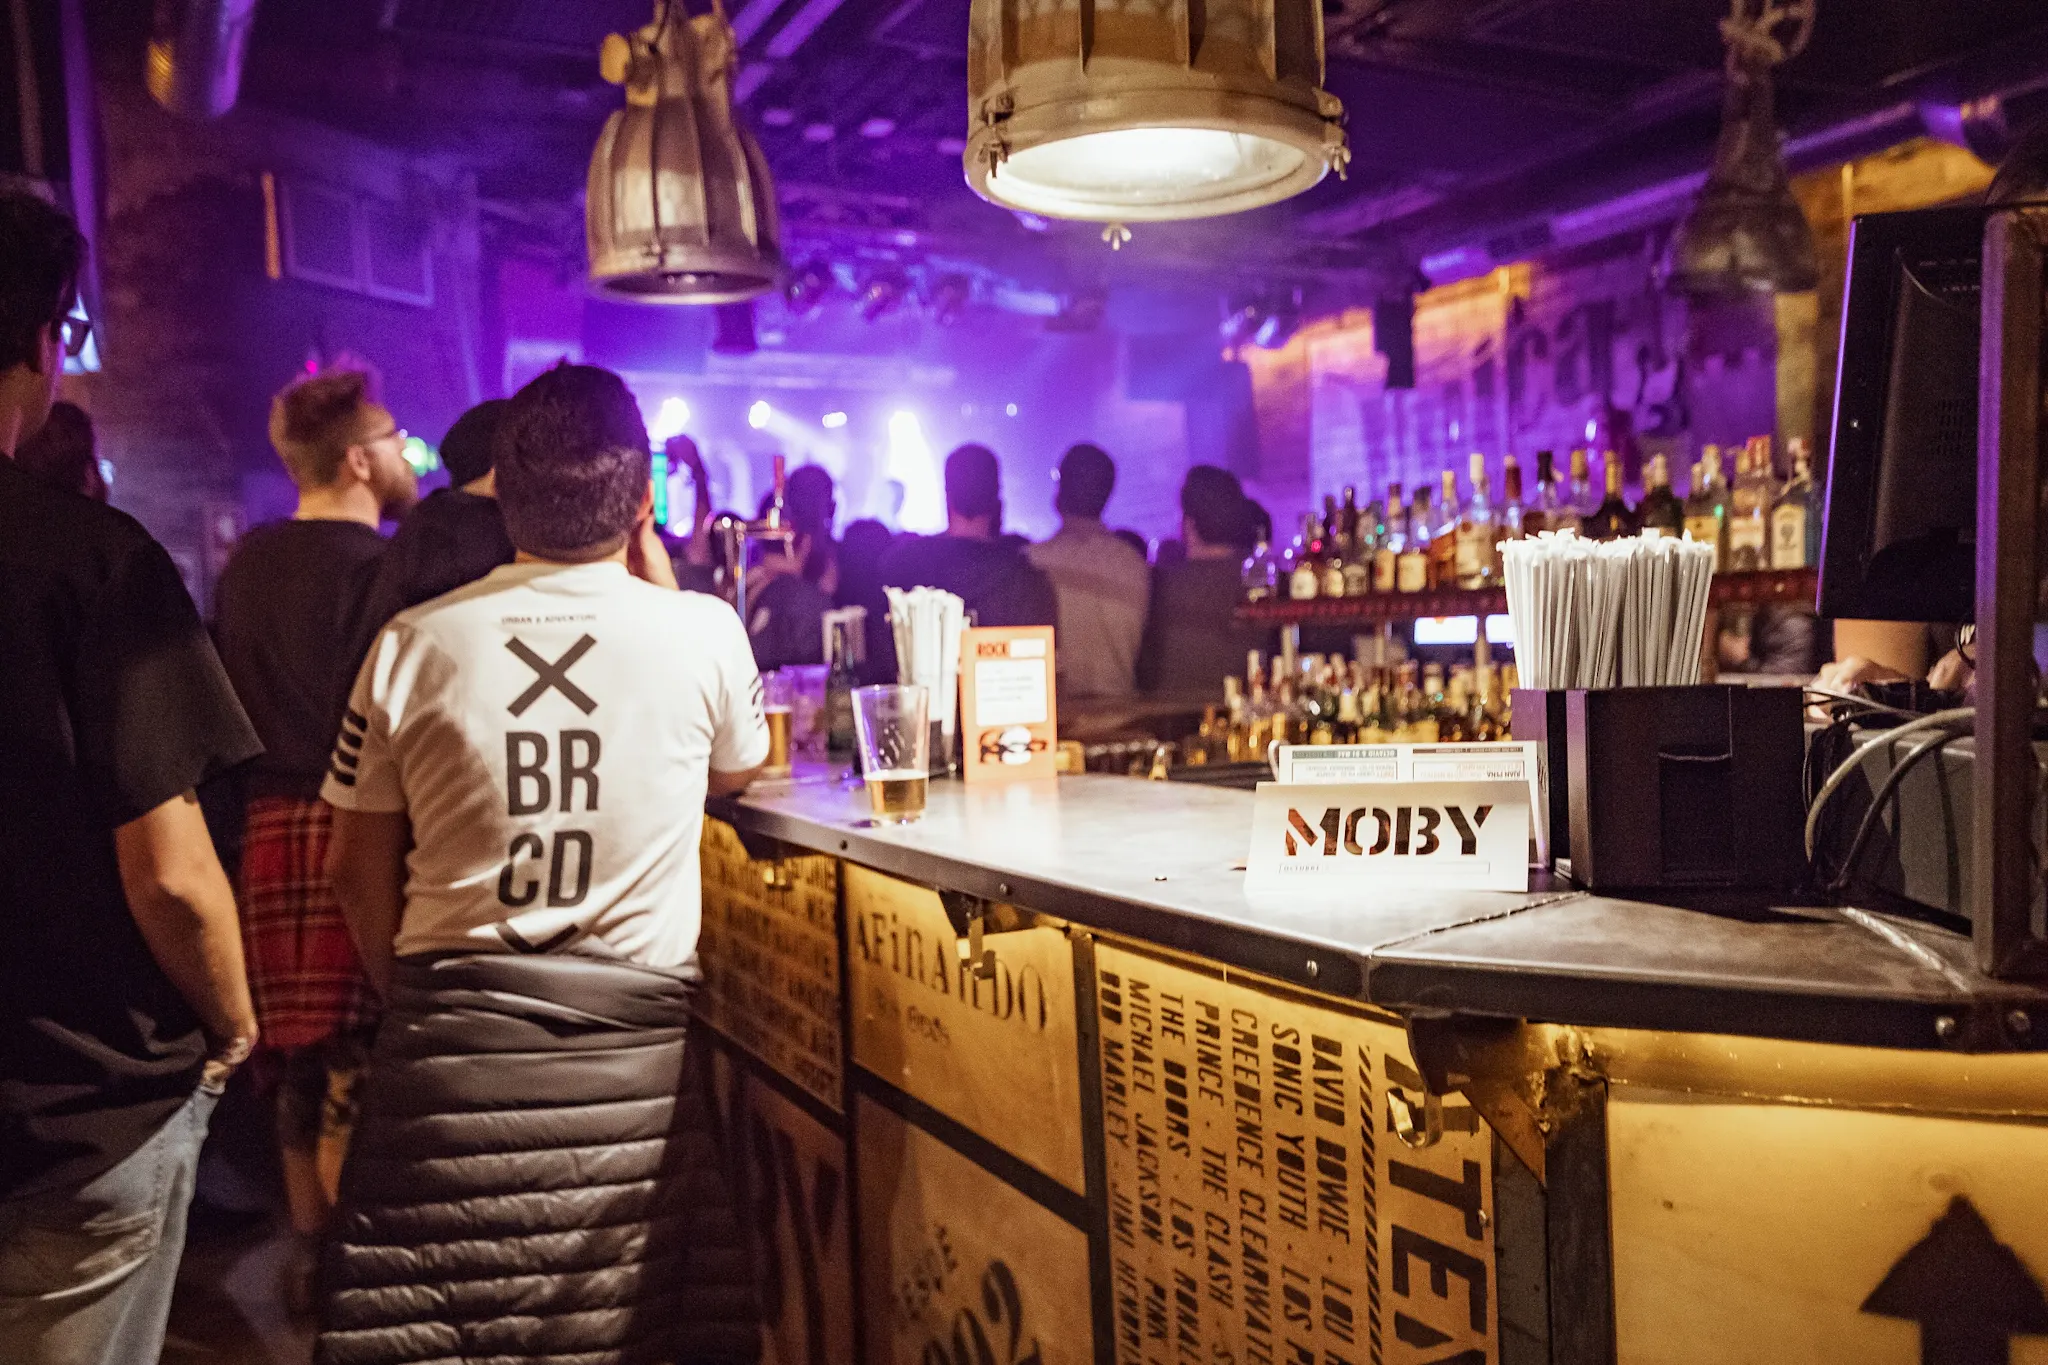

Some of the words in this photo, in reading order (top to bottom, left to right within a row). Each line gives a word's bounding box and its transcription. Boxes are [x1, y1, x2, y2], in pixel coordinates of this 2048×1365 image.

[505, 729, 600, 817] BR
[496, 829, 594, 908] CD
[1284, 805, 1493, 856] MOBY
[1128, 978, 1156, 1094] MICHAEL
[1160, 992, 1186, 1045] THE
[1195, 1000, 1225, 1107] PRINCE
[1102, 1035, 1131, 1149] MARLEY
[1163, 1058, 1191, 1159] DOORS
[1231, 1008, 1265, 1178] CREEDENCE
[1271, 1023, 1304, 1116] SONIC
[1311, 1034, 1345, 1126] DAVID
[1135, 1112, 1164, 1245] JACKSON
[1201, 1147, 1228, 1201] THE
[1275, 1132, 1309, 1231] YOUTH
[1315, 1136, 1350, 1245] BOWIE
[1169, 1197, 1196, 1258] LOS
[1205, 1211, 1235, 1310] CLASH
[1281, 1265, 1313, 1331] LOS
[1321, 1275, 1355, 1344] LOU
